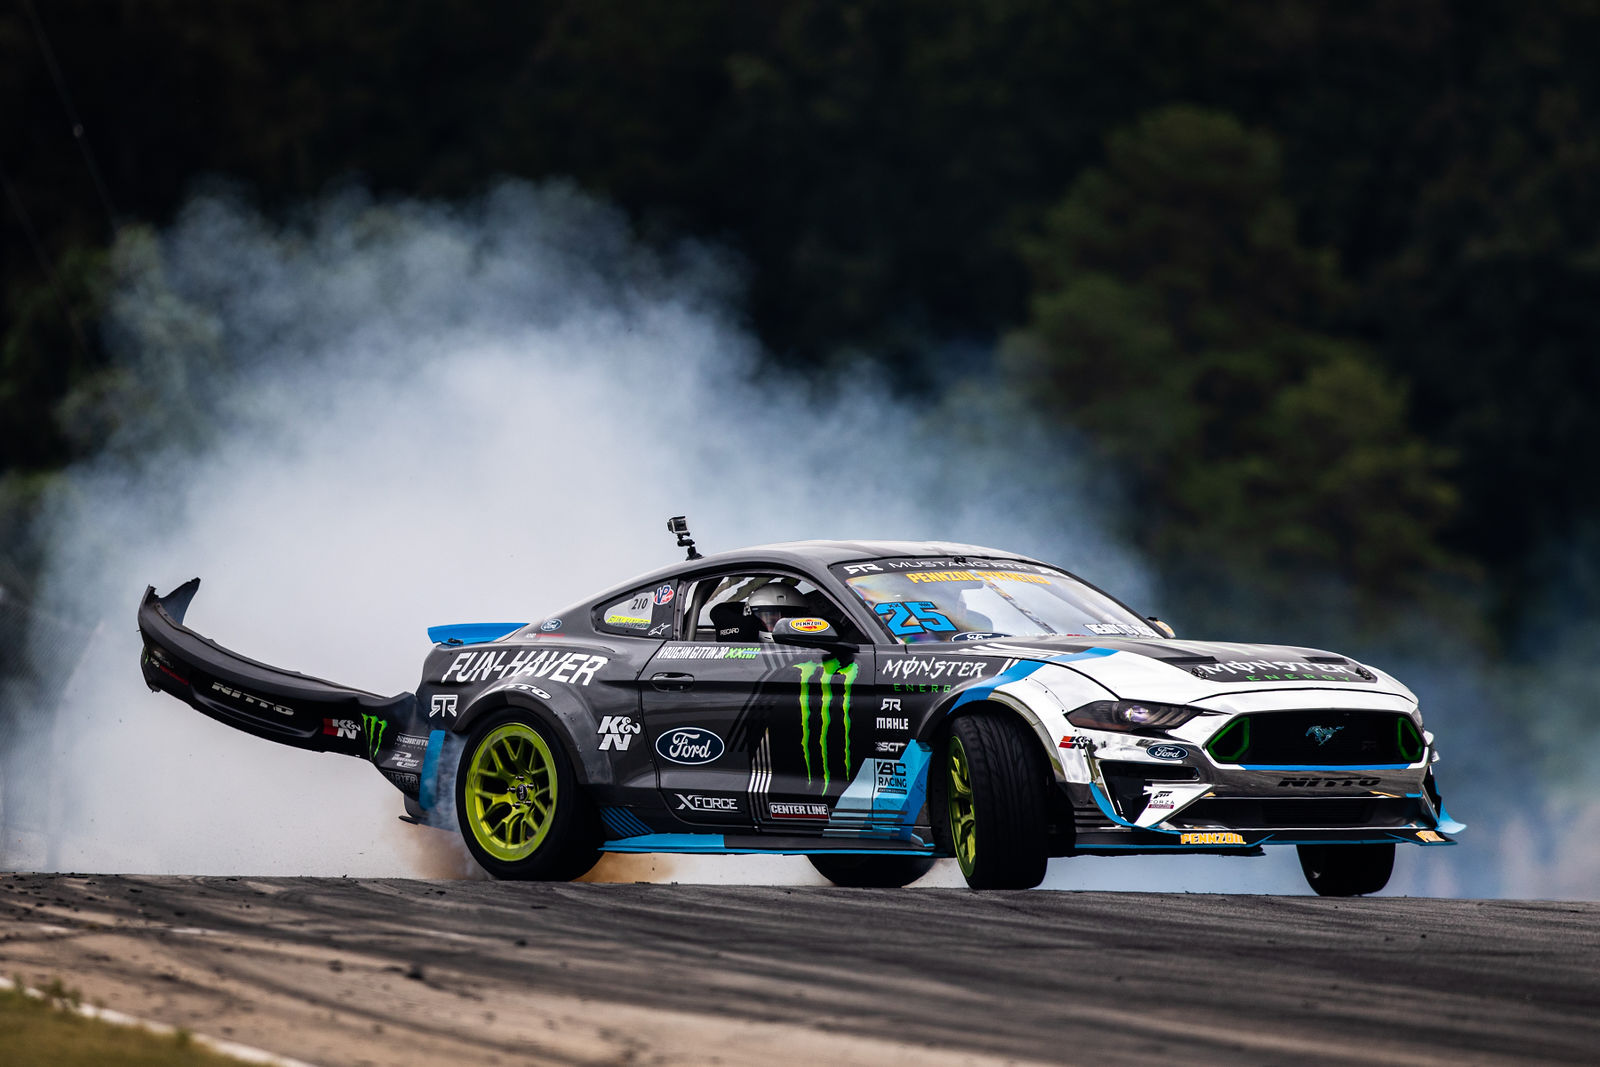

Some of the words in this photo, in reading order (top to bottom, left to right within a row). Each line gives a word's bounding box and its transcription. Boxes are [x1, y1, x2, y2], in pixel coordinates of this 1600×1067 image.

[905, 571, 982, 584] PENNZOIL
[631, 598, 649, 610] 210
[873, 601, 960, 636] 25
[441, 650, 608, 686] FUN-HAVER
[1245, 673, 1351, 682] ENERGY
[893, 683, 952, 693] ENERG
[211, 681, 295, 716] NITTO
[876, 717, 909, 730] MAHLE
[668, 731, 712, 759] Ford
[1153, 746, 1181, 758] Ford
[878, 777, 907, 788] RACING
[1278, 777, 1382, 787] NITTO
[770, 803, 806, 815] CENTER
[807, 804, 828, 815] LINE
